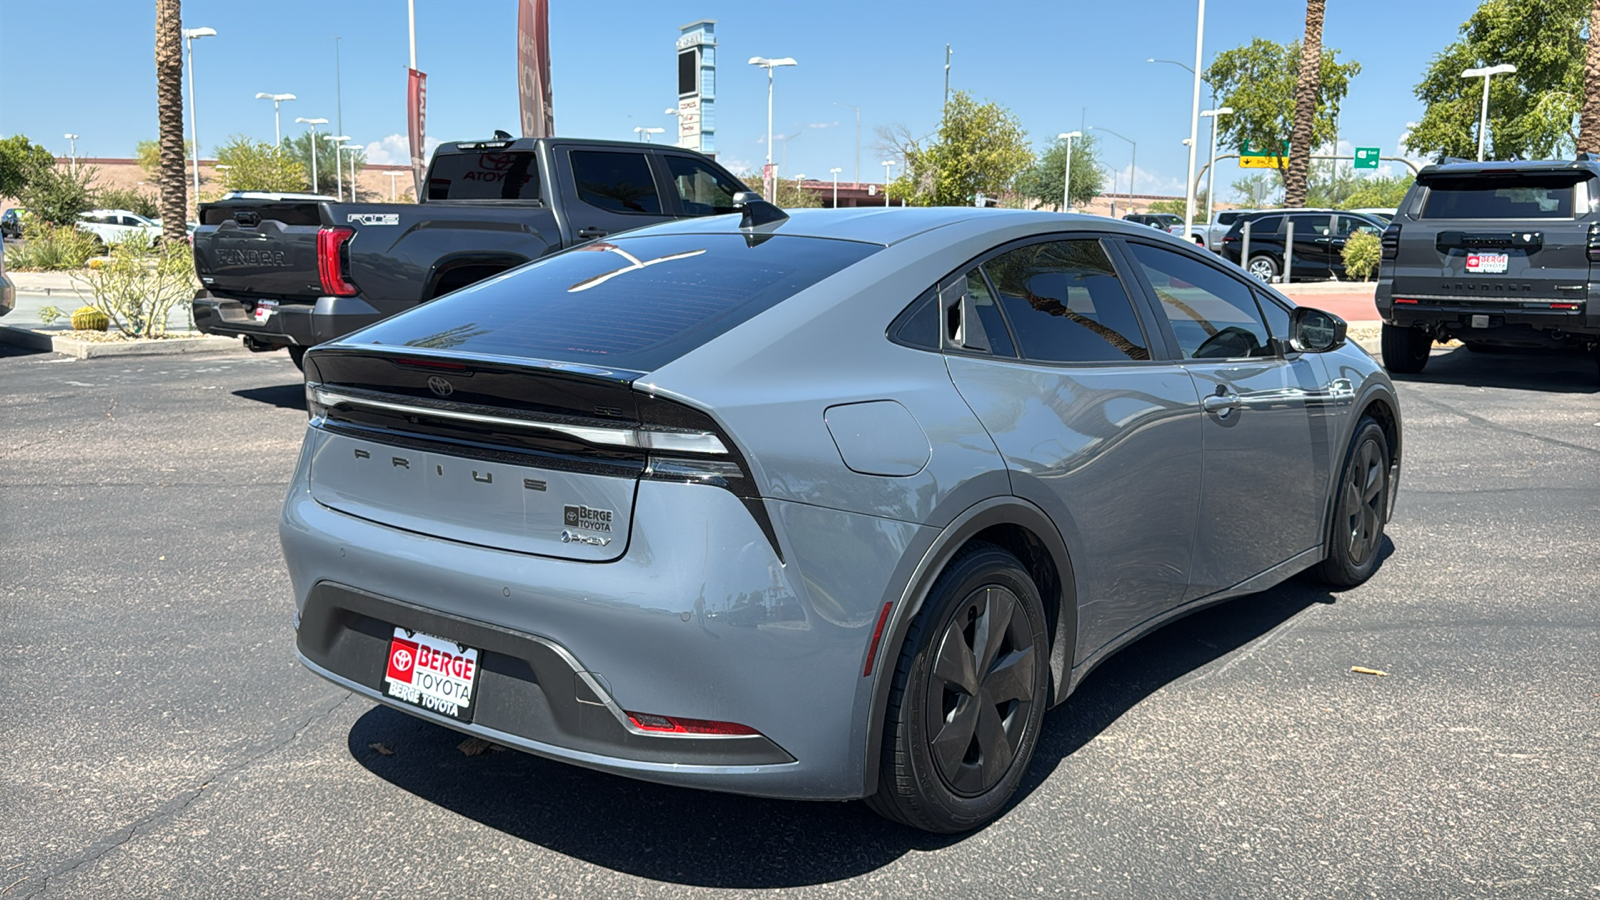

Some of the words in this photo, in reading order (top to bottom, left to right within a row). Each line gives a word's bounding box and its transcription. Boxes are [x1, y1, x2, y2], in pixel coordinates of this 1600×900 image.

[214, 249, 286, 267] TUNDRA
[354, 449, 547, 492] PRIUS
[579, 520, 611, 532] TOYOTA
[580, 505, 612, 522] BERGE
[418, 644, 474, 680] BERGE
[388, 681, 421, 704] BERGE
[422, 693, 459, 717] TOYOTA
[416, 671, 470, 699] TOYOTA
